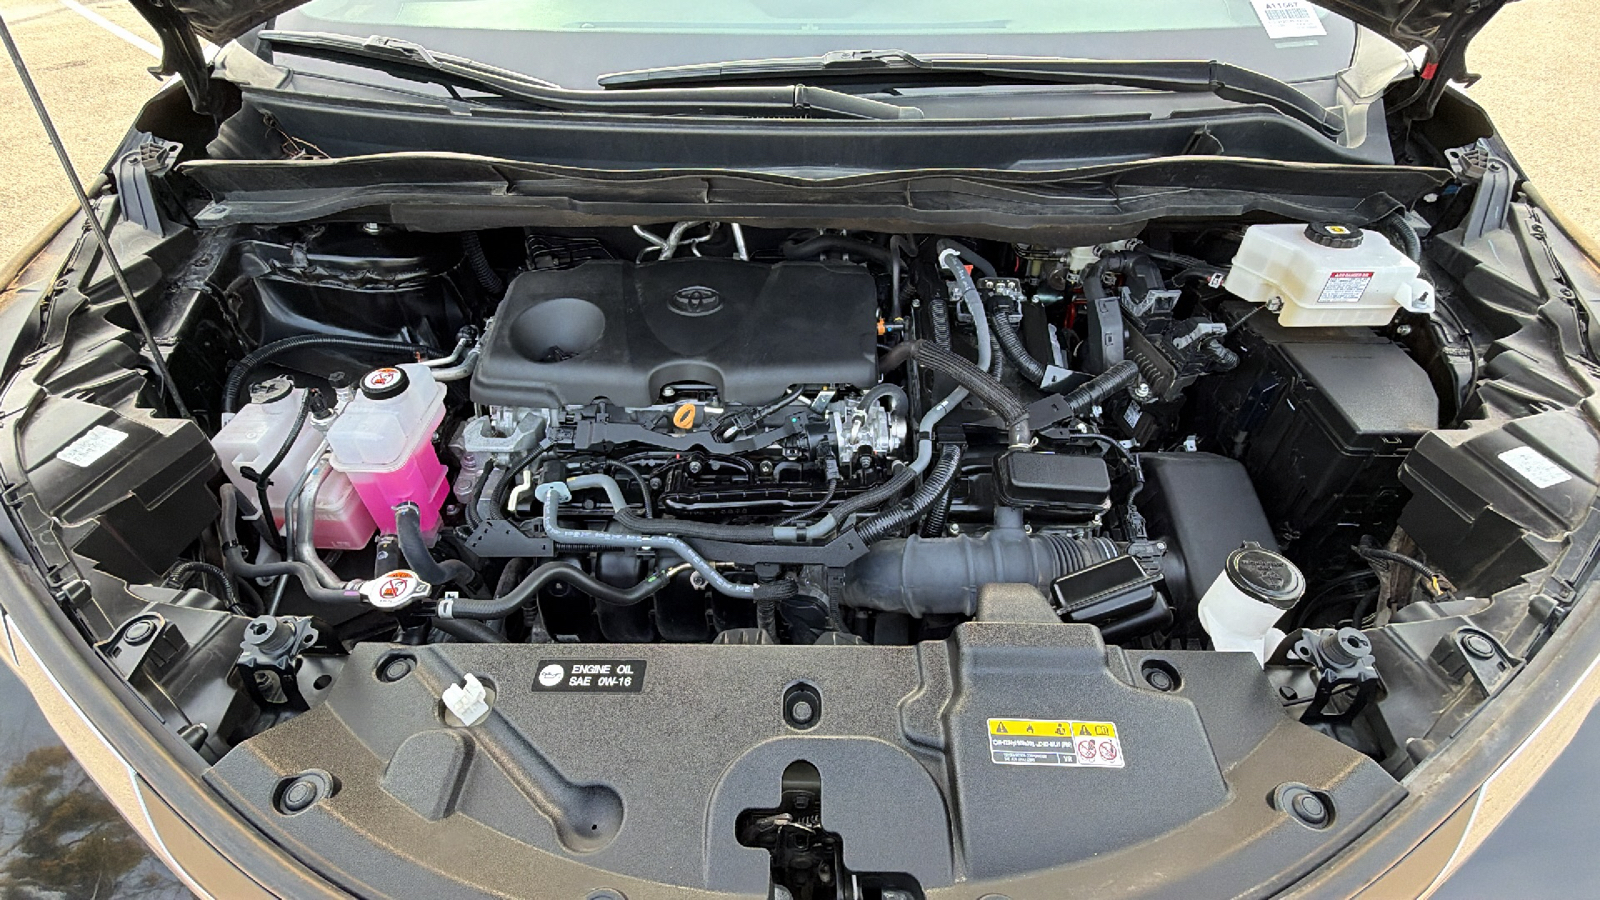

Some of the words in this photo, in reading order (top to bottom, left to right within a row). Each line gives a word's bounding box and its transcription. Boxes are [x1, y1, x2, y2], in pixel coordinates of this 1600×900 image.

[571, 664, 611, 674] ENGINE
[616, 664, 634, 674] OIL
[568, 676, 592, 686] SAE
[597, 676, 632, 686] 0W-16
